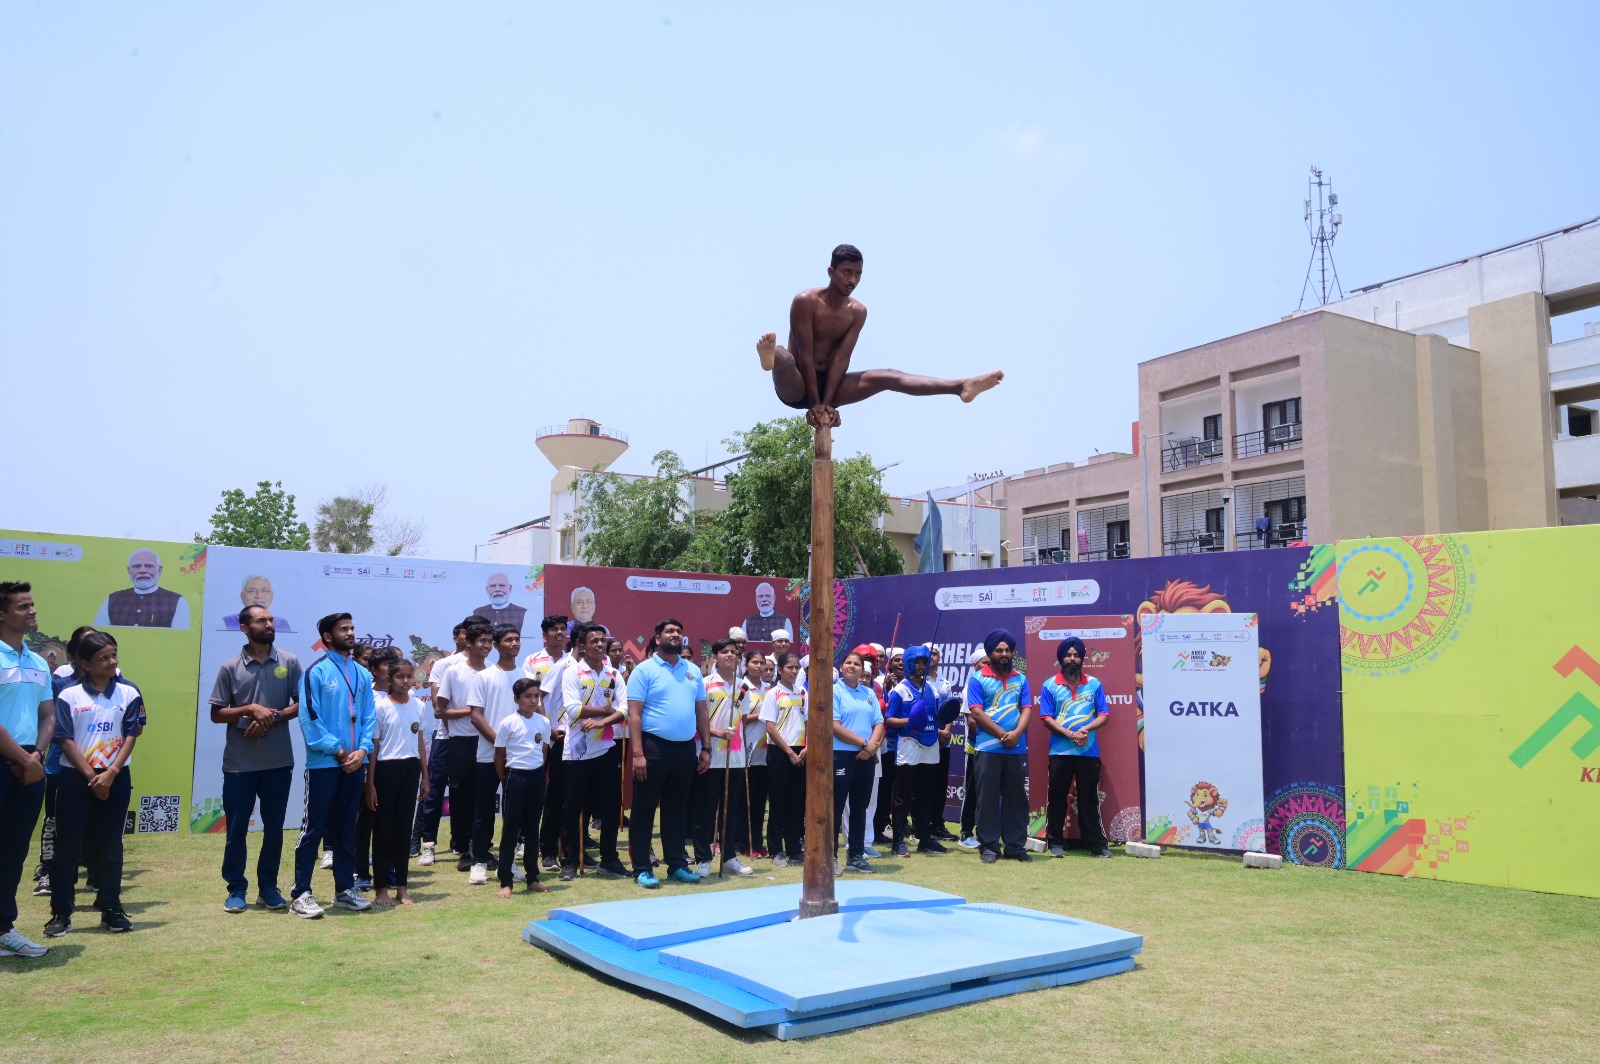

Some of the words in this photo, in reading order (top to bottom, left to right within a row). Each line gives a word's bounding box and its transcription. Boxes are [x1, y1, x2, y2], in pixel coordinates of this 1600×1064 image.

[1033, 587, 1047, 597] FIT
[1169, 700, 1240, 717] GATKA
[96, 721, 114, 732] SBI
